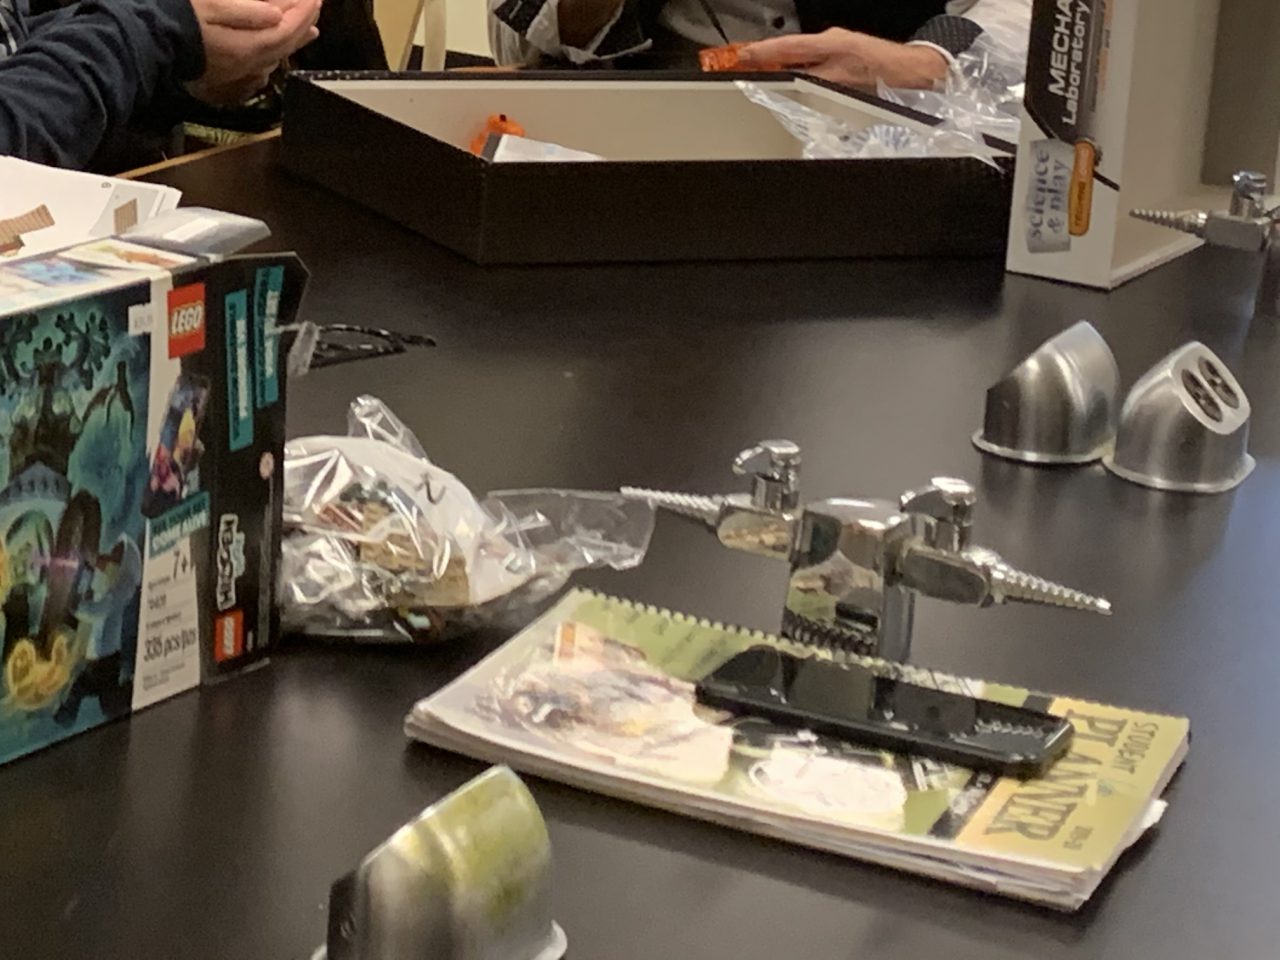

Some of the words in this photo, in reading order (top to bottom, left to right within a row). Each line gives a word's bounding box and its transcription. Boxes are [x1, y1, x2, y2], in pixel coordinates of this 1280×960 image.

[1061, 0, 1092, 126] Laboratory
[1027, 148, 1051, 240] science
[170, 302, 204, 337] LEGO
[982, 708, 1128, 842] PLANNER
[1111, 720, 1160, 776] STUDENT
